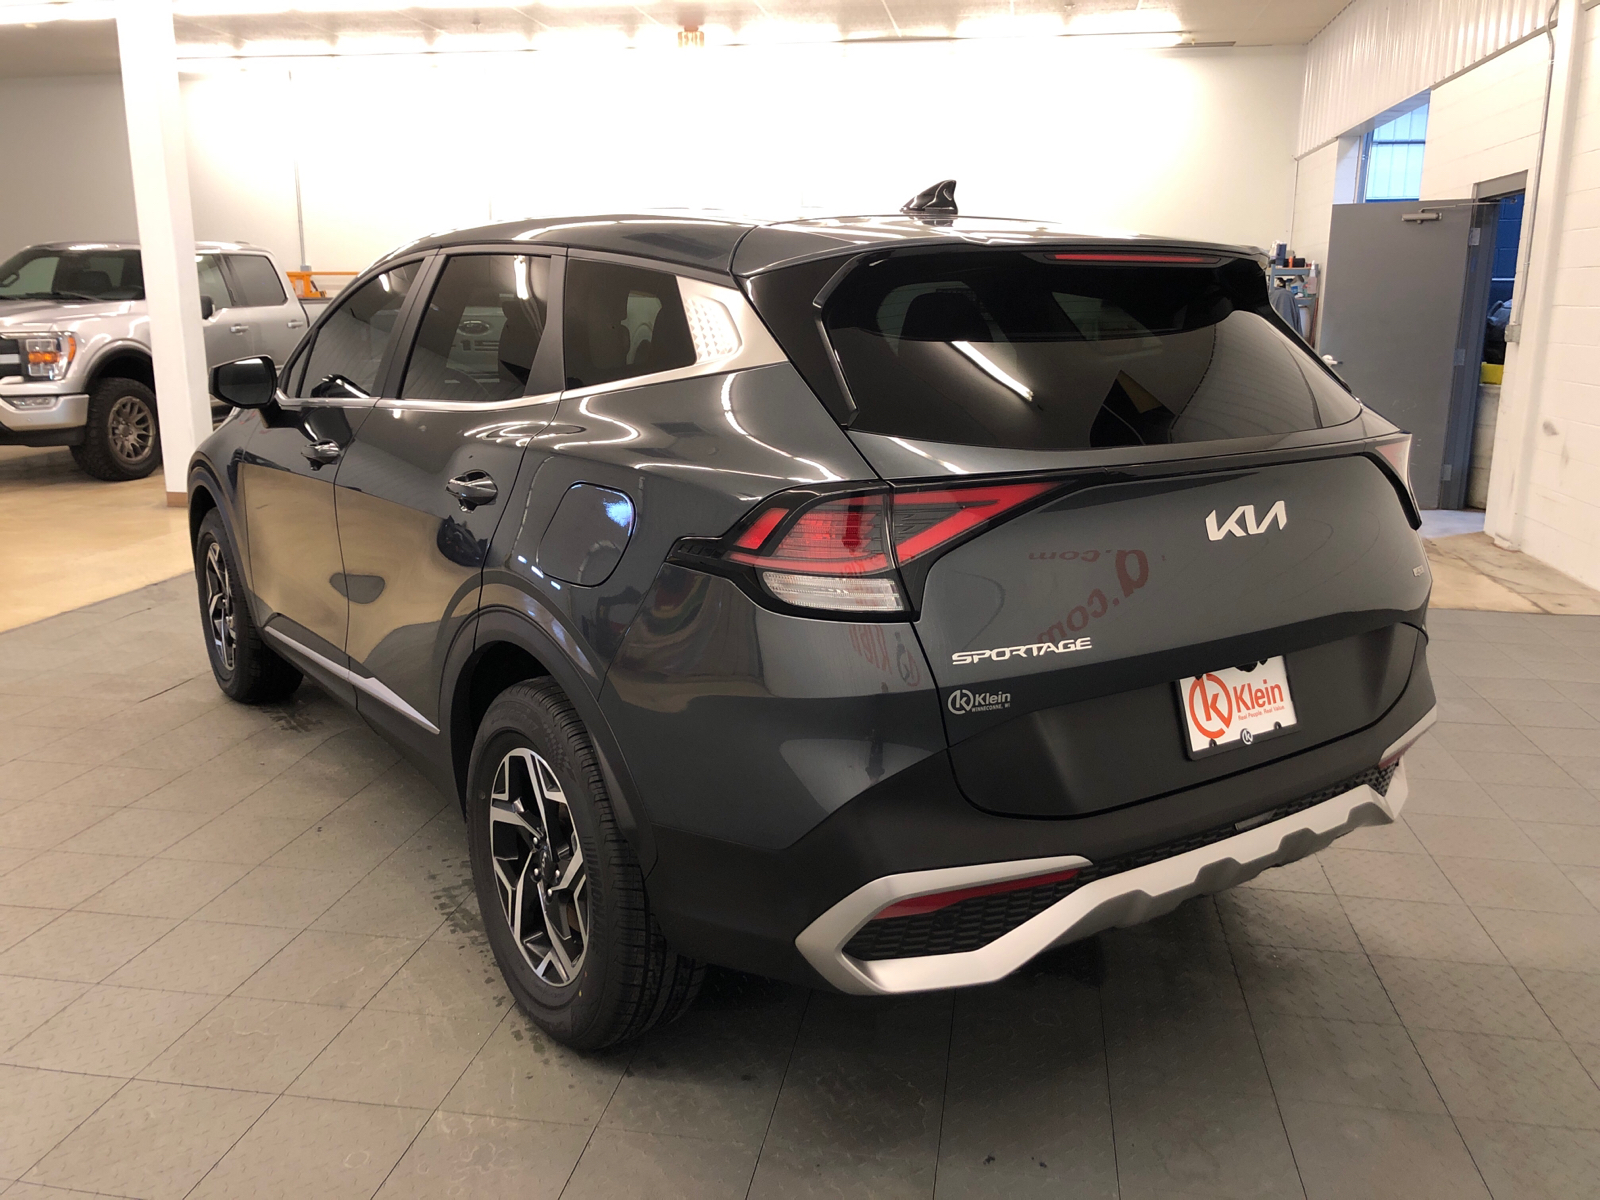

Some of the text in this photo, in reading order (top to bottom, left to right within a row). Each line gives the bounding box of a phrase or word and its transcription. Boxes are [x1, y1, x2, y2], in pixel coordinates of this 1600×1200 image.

[1205, 500, 1288, 541] KIA
[951, 637, 1093, 665] SPORTAGE
[975, 692, 1010, 705] Klein
[1233, 679, 1283, 713] Klein
[1238, 713, 1248, 721] Real
